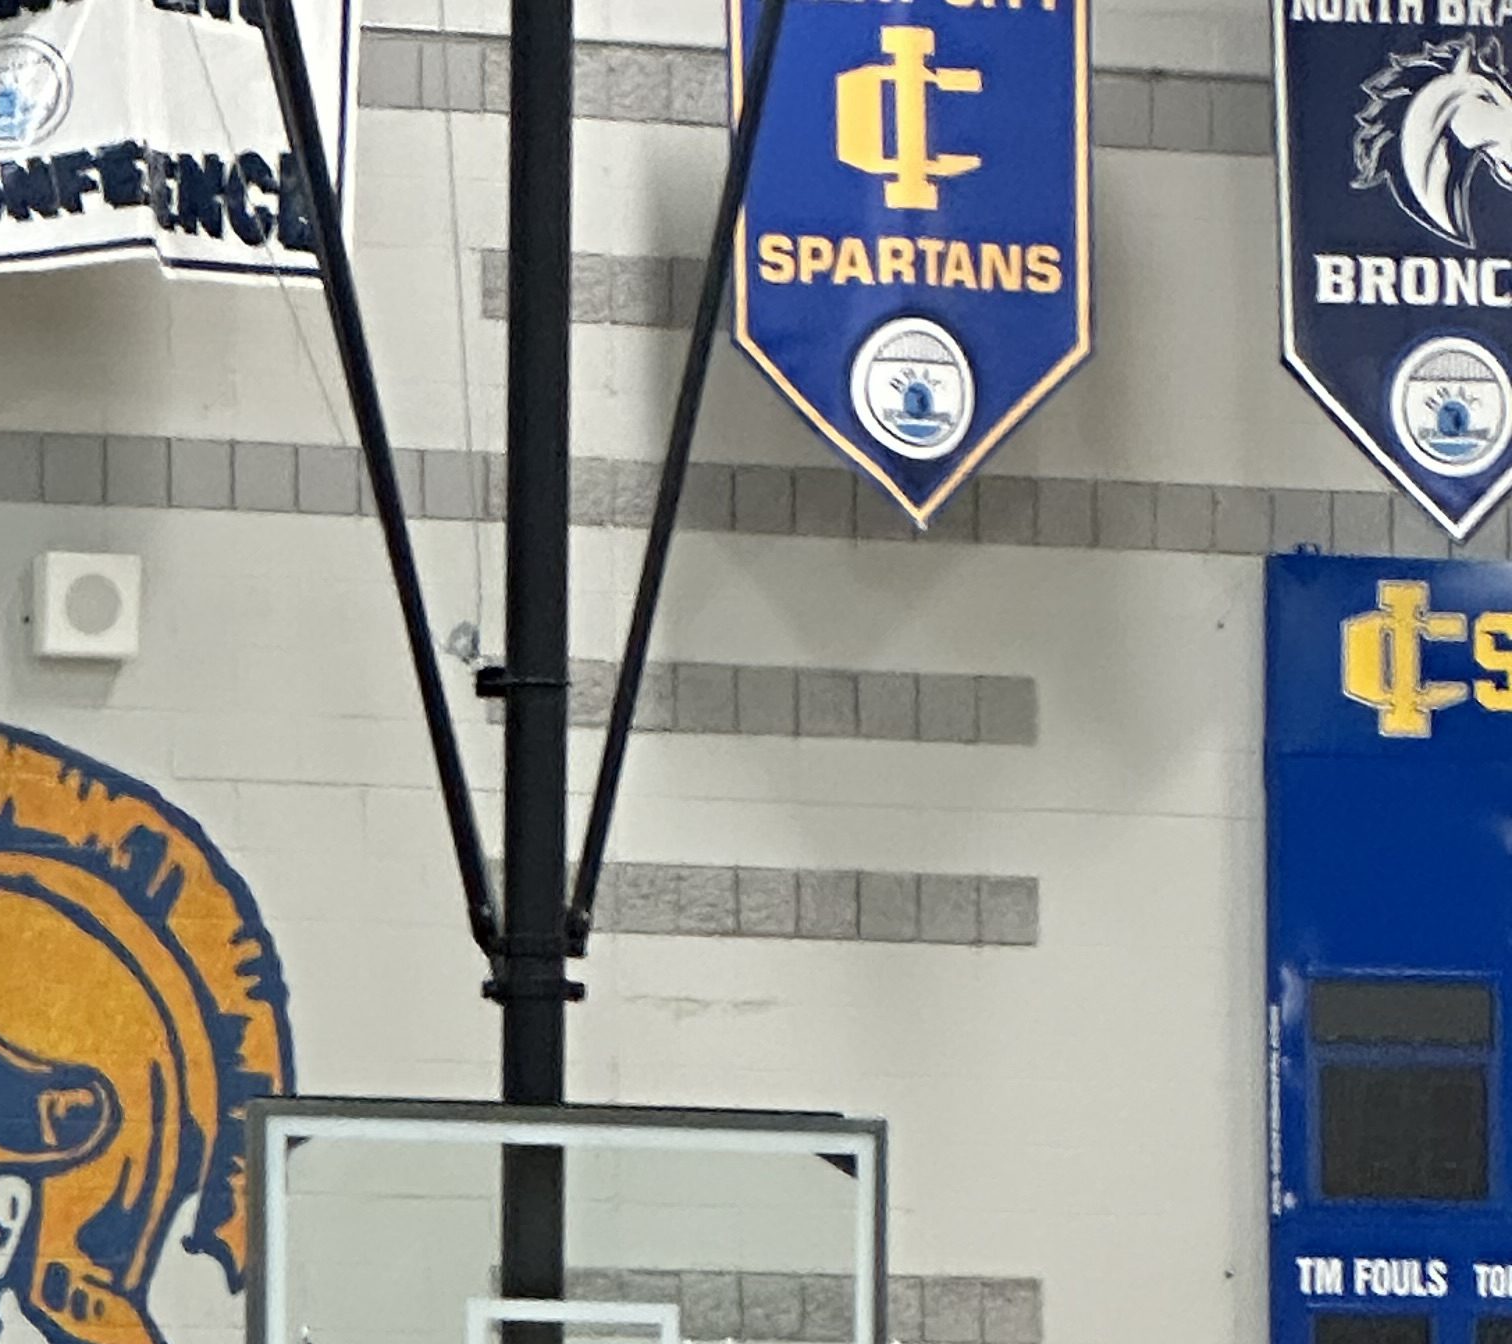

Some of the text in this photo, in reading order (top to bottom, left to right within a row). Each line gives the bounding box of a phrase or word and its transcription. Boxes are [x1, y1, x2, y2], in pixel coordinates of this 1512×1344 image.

[758, 234, 1062, 293] SPARTANS
[1295, 1256, 1449, 1297] TM FOULS
